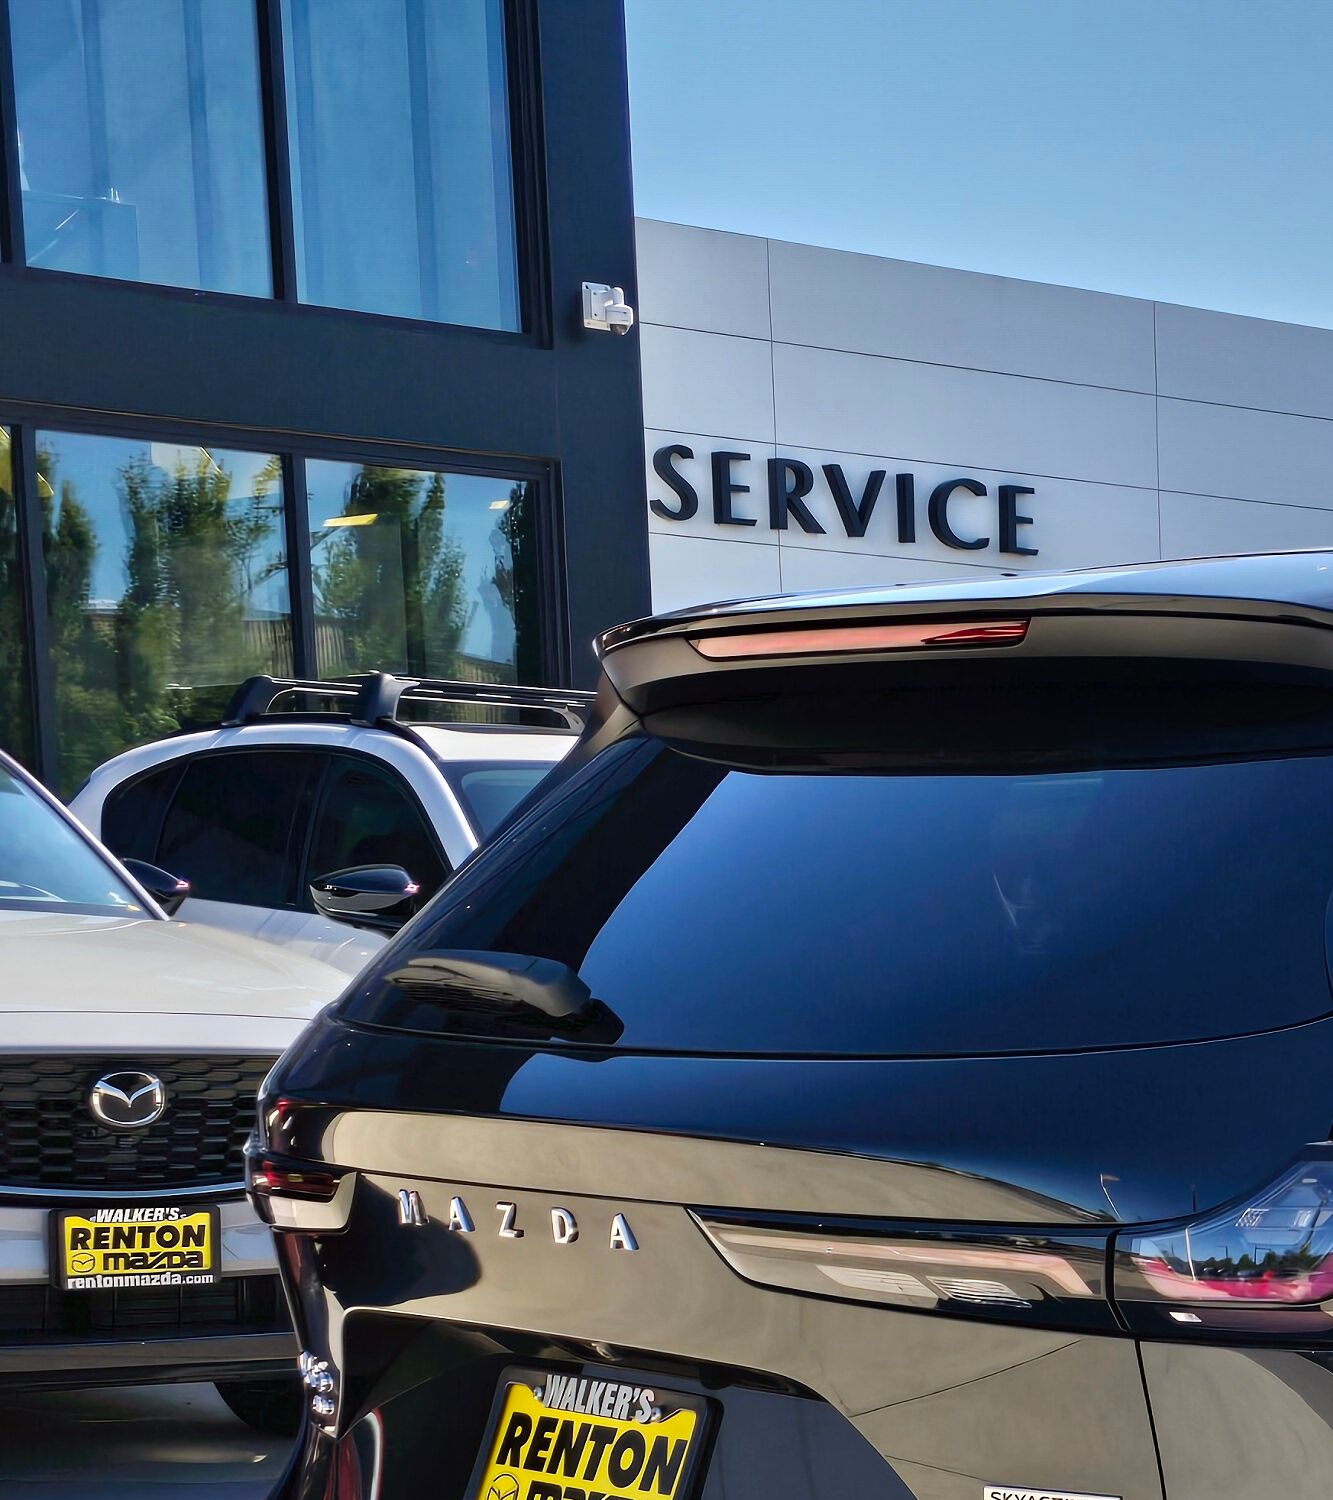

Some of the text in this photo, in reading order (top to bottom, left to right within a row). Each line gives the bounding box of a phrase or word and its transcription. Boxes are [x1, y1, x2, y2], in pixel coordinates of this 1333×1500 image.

[649, 444, 1039, 555] SERVICE
[96, 1207, 180, 1222] WALKER'S
[399, 1189, 640, 1251] MAZDA
[70, 1225, 206, 1250] RENTON
[103, 1251, 203, 1271] mazda
[67, 1272, 214, 1289] rentonmazda.com
[543, 1374, 656, 1424] WALKER'S
[496, 1411, 688, 1496] RENTON
